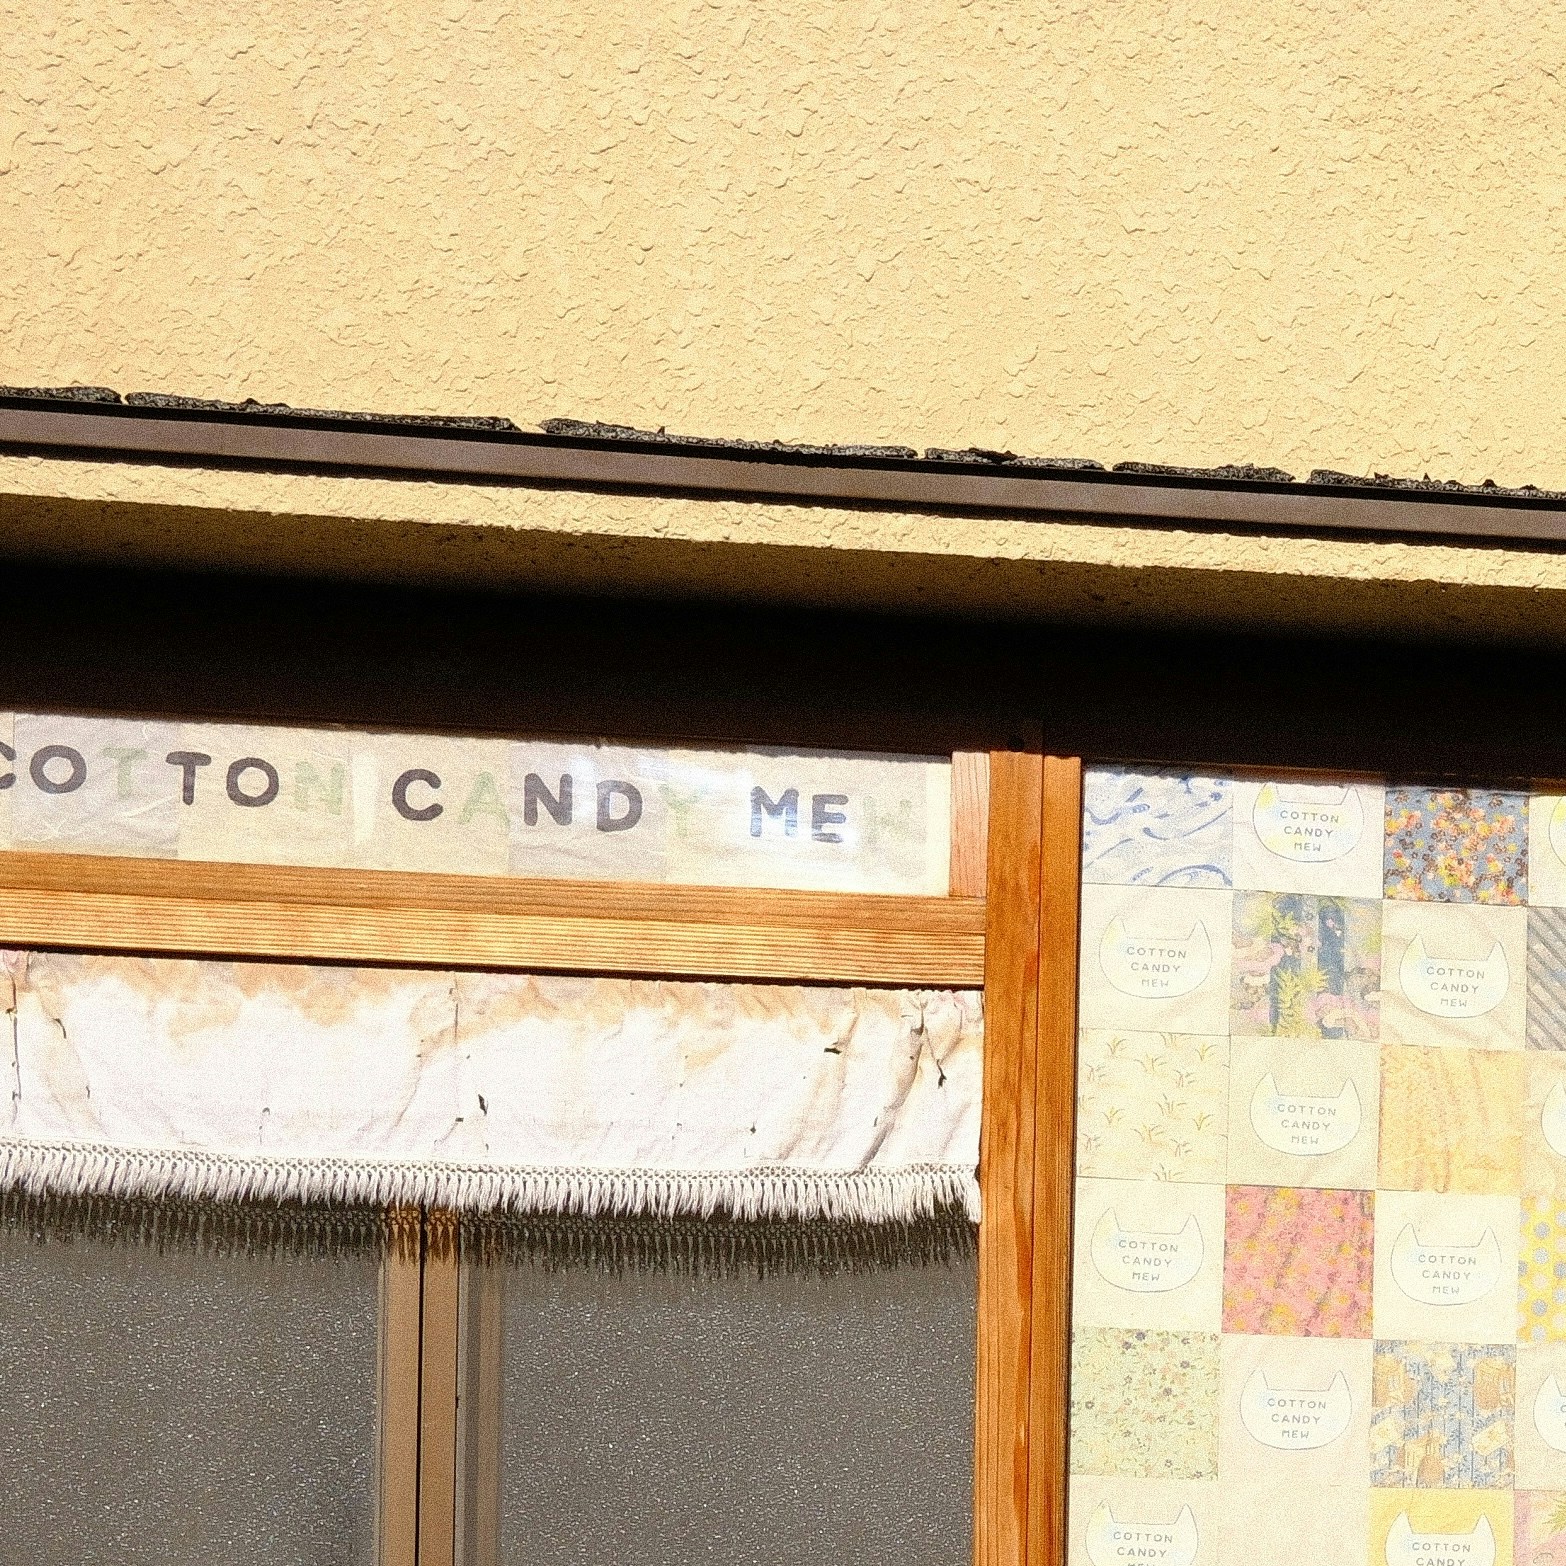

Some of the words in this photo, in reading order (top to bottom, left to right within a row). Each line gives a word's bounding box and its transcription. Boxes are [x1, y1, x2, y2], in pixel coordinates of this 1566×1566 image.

[390, 766, 707, 837] CANDY
[1280, 810, 1341, 824] COTTON
[1283, 825, 1334, 838] CANDY
[1294, 841, 1323, 852] MEW
[1125, 946, 1188, 960] COTTON
[1129, 962, 1181, 975] CANDY
[1425, 966, 1486, 981] COTTON
[1140, 977, 1171, 989] MEW
[1429, 981, 1480, 995] CANDY
[1439, 997, 1469, 1009] MEW
[1276, 1103, 1338, 1117] COTTON
[1280, 1118, 1331, 1132] CANDY
[1290, 1134, 1321, 1146] MEW
[1116, 1239, 1180, 1254] COTTON
[1120, 1254, 1173, 1268] CANDY
[1417, 1254, 1478, 1268] COTTON
[1131, 1270, 1162, 1283] MEW
[1421, 1268, 1472, 1282] CANDY
[1431, 1284, 1462, 1296] MEW
[1266, 1398, 1328, 1412] COTTON
[1270, 1413, 1322, 1426] CANDY
[1280, 1428, 1311, 1440] MEW
[1112, 1531, 1175, 1545] COTTON
[1116, 1546, 1168, 1560] CANDY
[1411, 1541, 1472, 1555] COTTON
